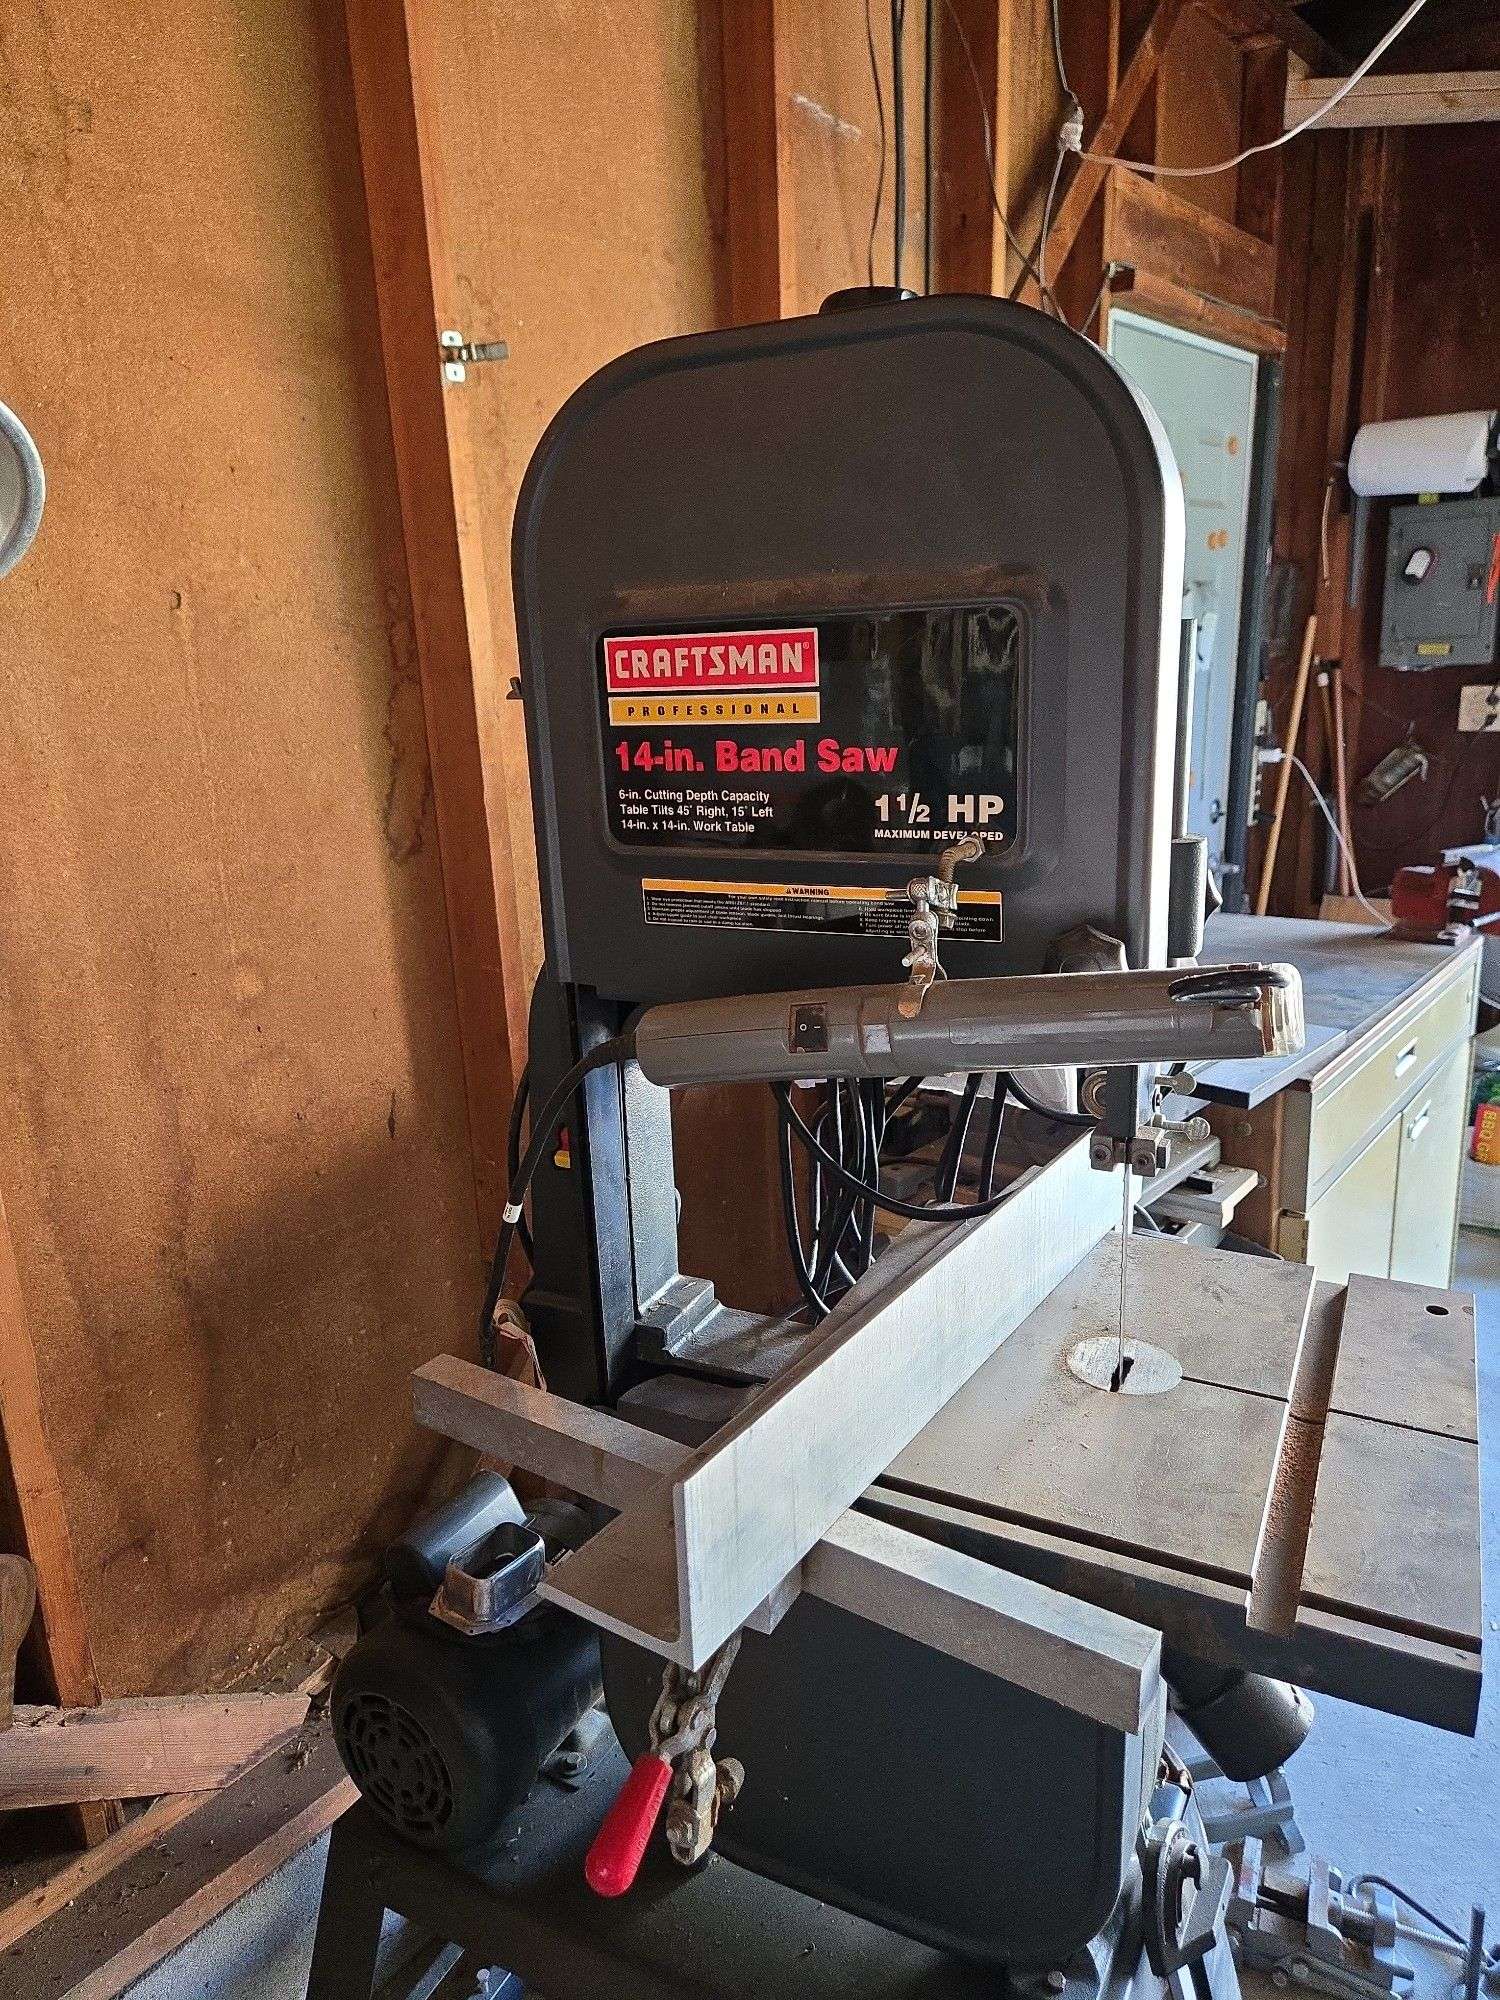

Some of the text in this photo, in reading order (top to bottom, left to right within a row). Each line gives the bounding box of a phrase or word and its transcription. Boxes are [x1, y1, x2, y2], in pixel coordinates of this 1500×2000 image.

[627, 702, 800, 717] PROFESSIONAL
[616, 738, 898, 773] 14-in. Band Saw
[619, 789, 770, 804] 6-in. Cutting Depth Capacity
[620, 804, 649, 815] Table
[651, 804, 674, 815] Tilts
[696, 805, 729, 818] Right,
[751, 805, 773, 818] Left
[948, 795, 1004, 824] HP
[621, 819, 755, 833] 14-in. x 14-in. Work Table
[874, 829, 930, 839] MAXIMUM
[792, 887, 830, 896] WARNING
